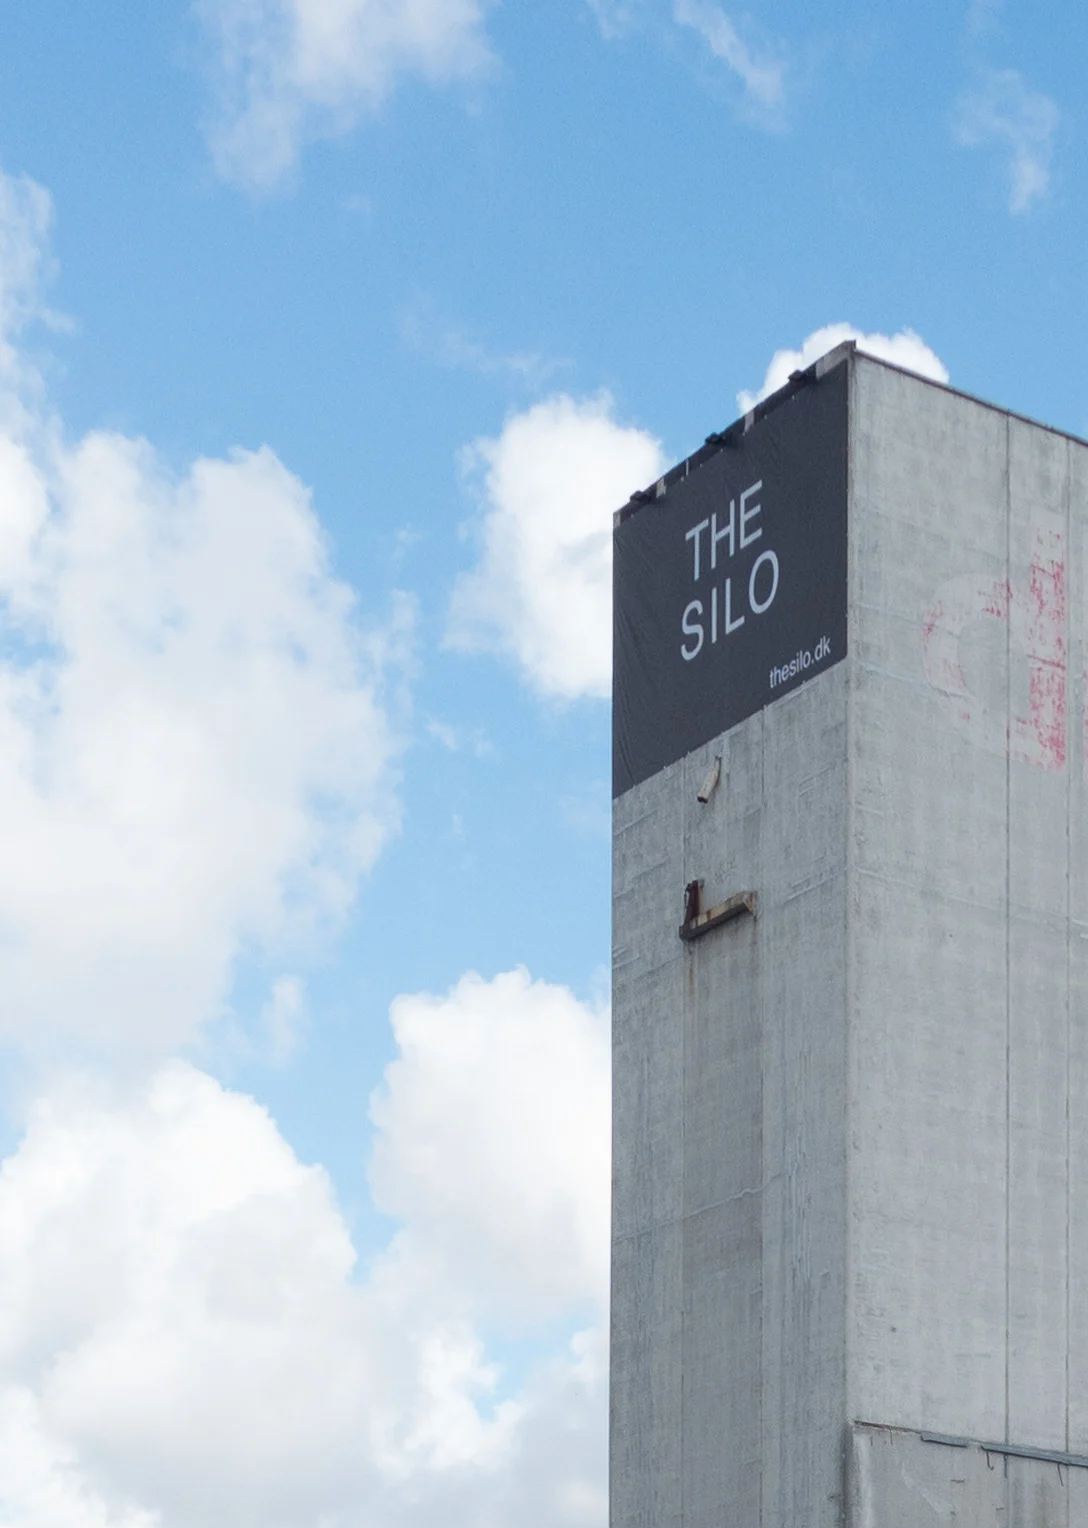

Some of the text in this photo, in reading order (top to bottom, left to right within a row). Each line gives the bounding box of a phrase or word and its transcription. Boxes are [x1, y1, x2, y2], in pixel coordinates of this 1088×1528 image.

[685, 479, 763, 581] THE
[680, 550, 779, 661] SILO
[769, 635, 831, 688] thesilo.dk
